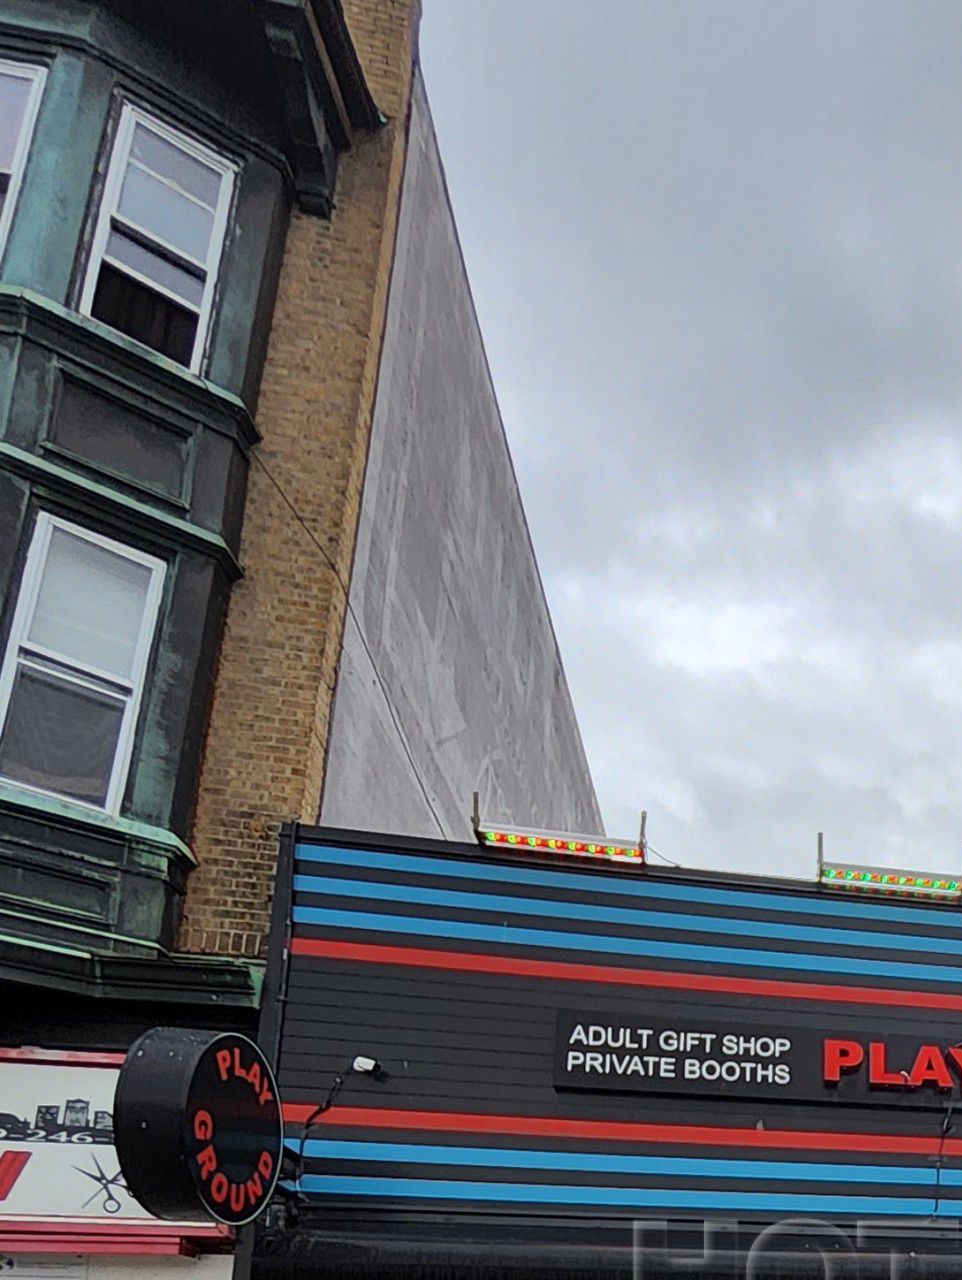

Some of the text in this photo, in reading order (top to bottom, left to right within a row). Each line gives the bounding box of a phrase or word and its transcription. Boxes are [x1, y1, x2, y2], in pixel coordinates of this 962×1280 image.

[569, 1025, 791, 1058] ADULT GIFT SHOP
[216, 1047, 273, 1105] PLAY
[566, 1051, 791, 1085] PRIVATE BOOTHS
[194, 1110, 273, 1212] GROUND
